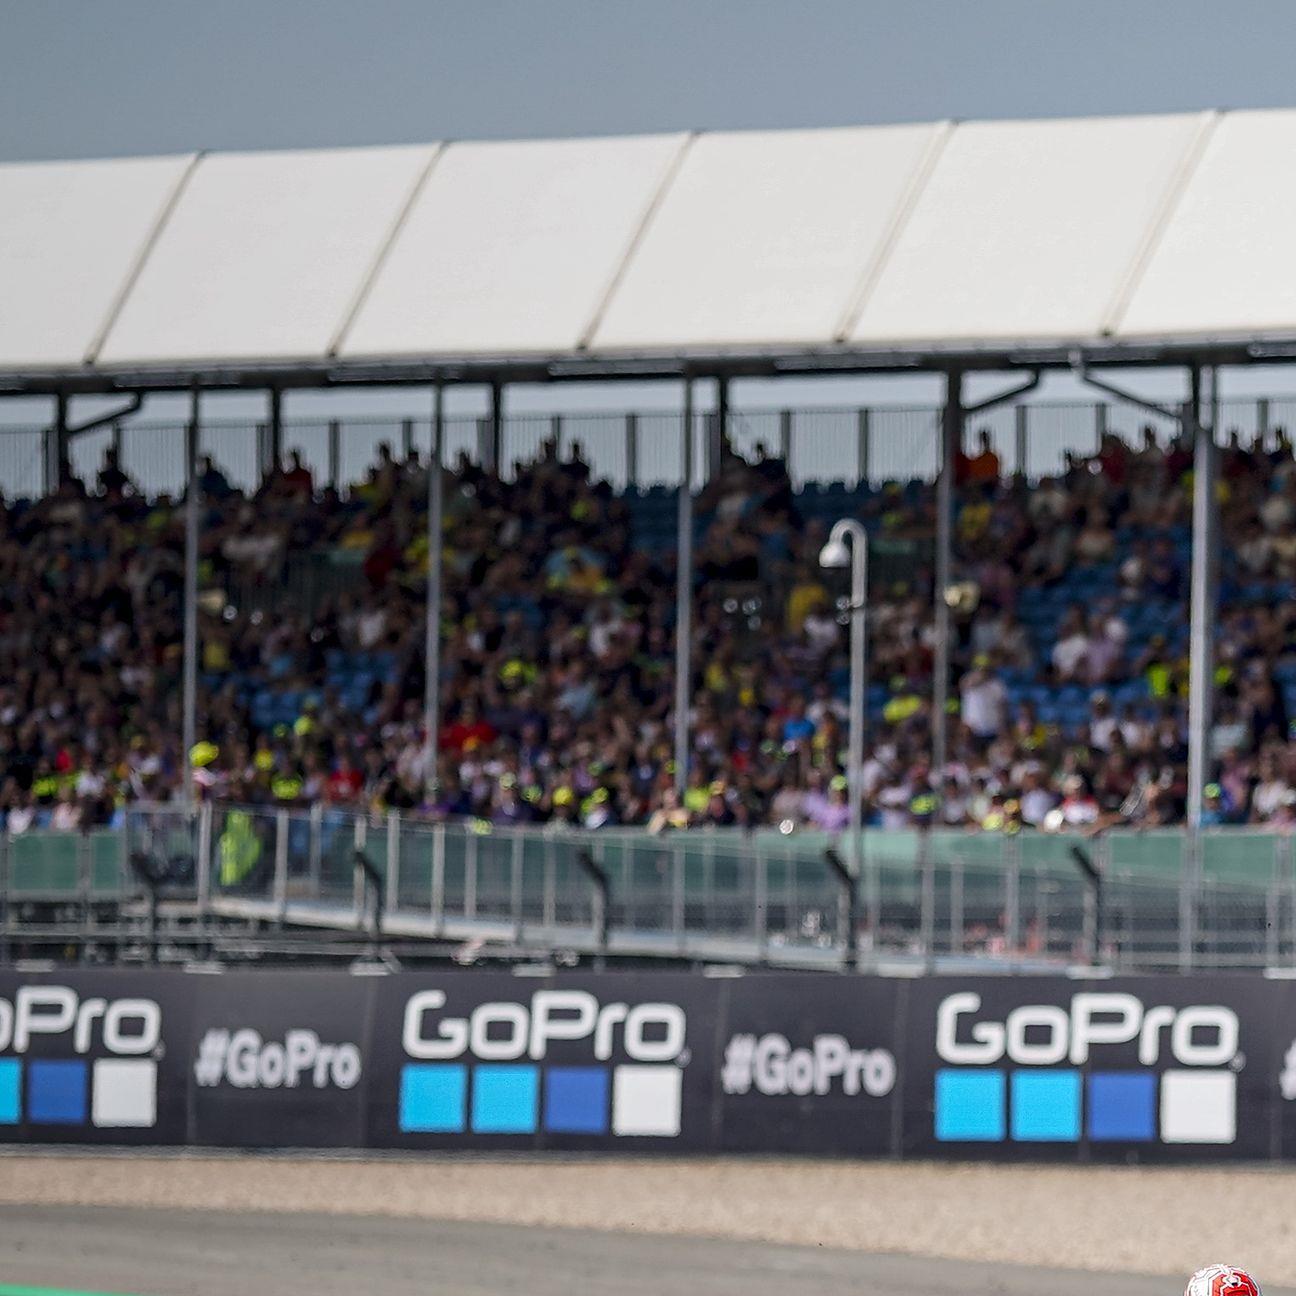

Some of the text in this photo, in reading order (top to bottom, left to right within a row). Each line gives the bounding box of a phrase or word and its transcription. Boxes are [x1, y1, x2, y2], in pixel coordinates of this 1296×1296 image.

[194, 1028, 362, 1089] #GoPro
[402, 989, 686, 1061] GoPro
[935, 992, 1239, 1065] GoPro
[722, 1032, 896, 1097] #GoPro
